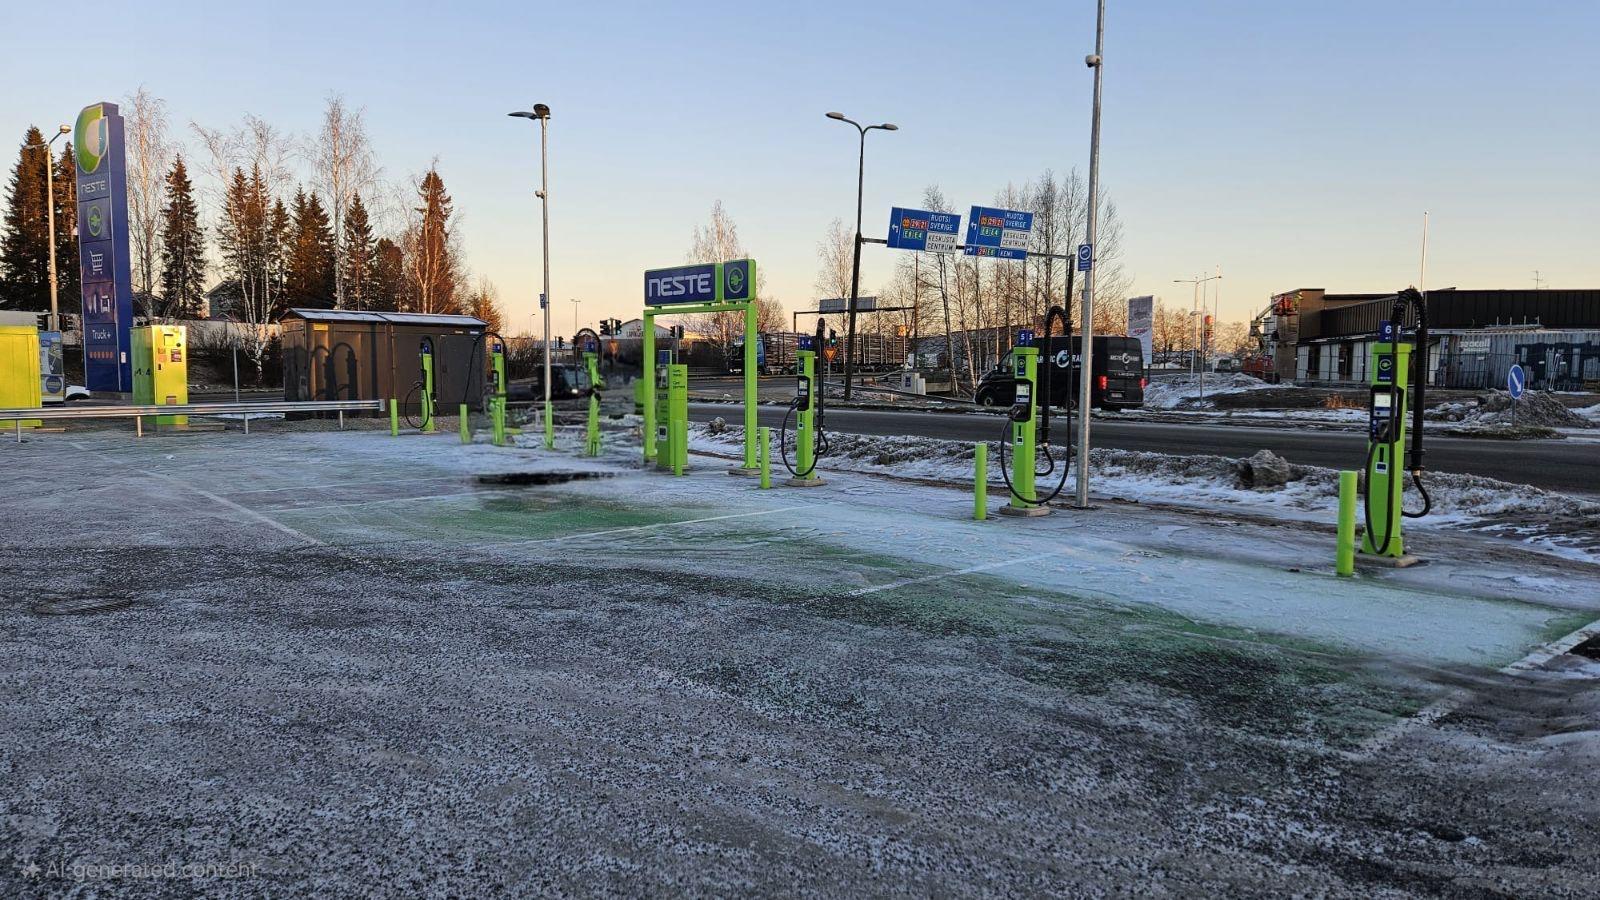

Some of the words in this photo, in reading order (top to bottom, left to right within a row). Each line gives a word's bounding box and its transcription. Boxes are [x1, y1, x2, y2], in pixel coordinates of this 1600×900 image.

[81, 180, 106, 195] NESTE
[931, 214, 951, 223] RUOTSI
[930, 222, 953, 231] SVERIGE
[1006, 220, 1027, 228] SVERIGE
[928, 235, 956, 243] KESKUSTA
[927, 242, 954, 250] CENTRUM
[649, 273, 711, 297] NESTE
[1385, 325, 1392, 334] 6
